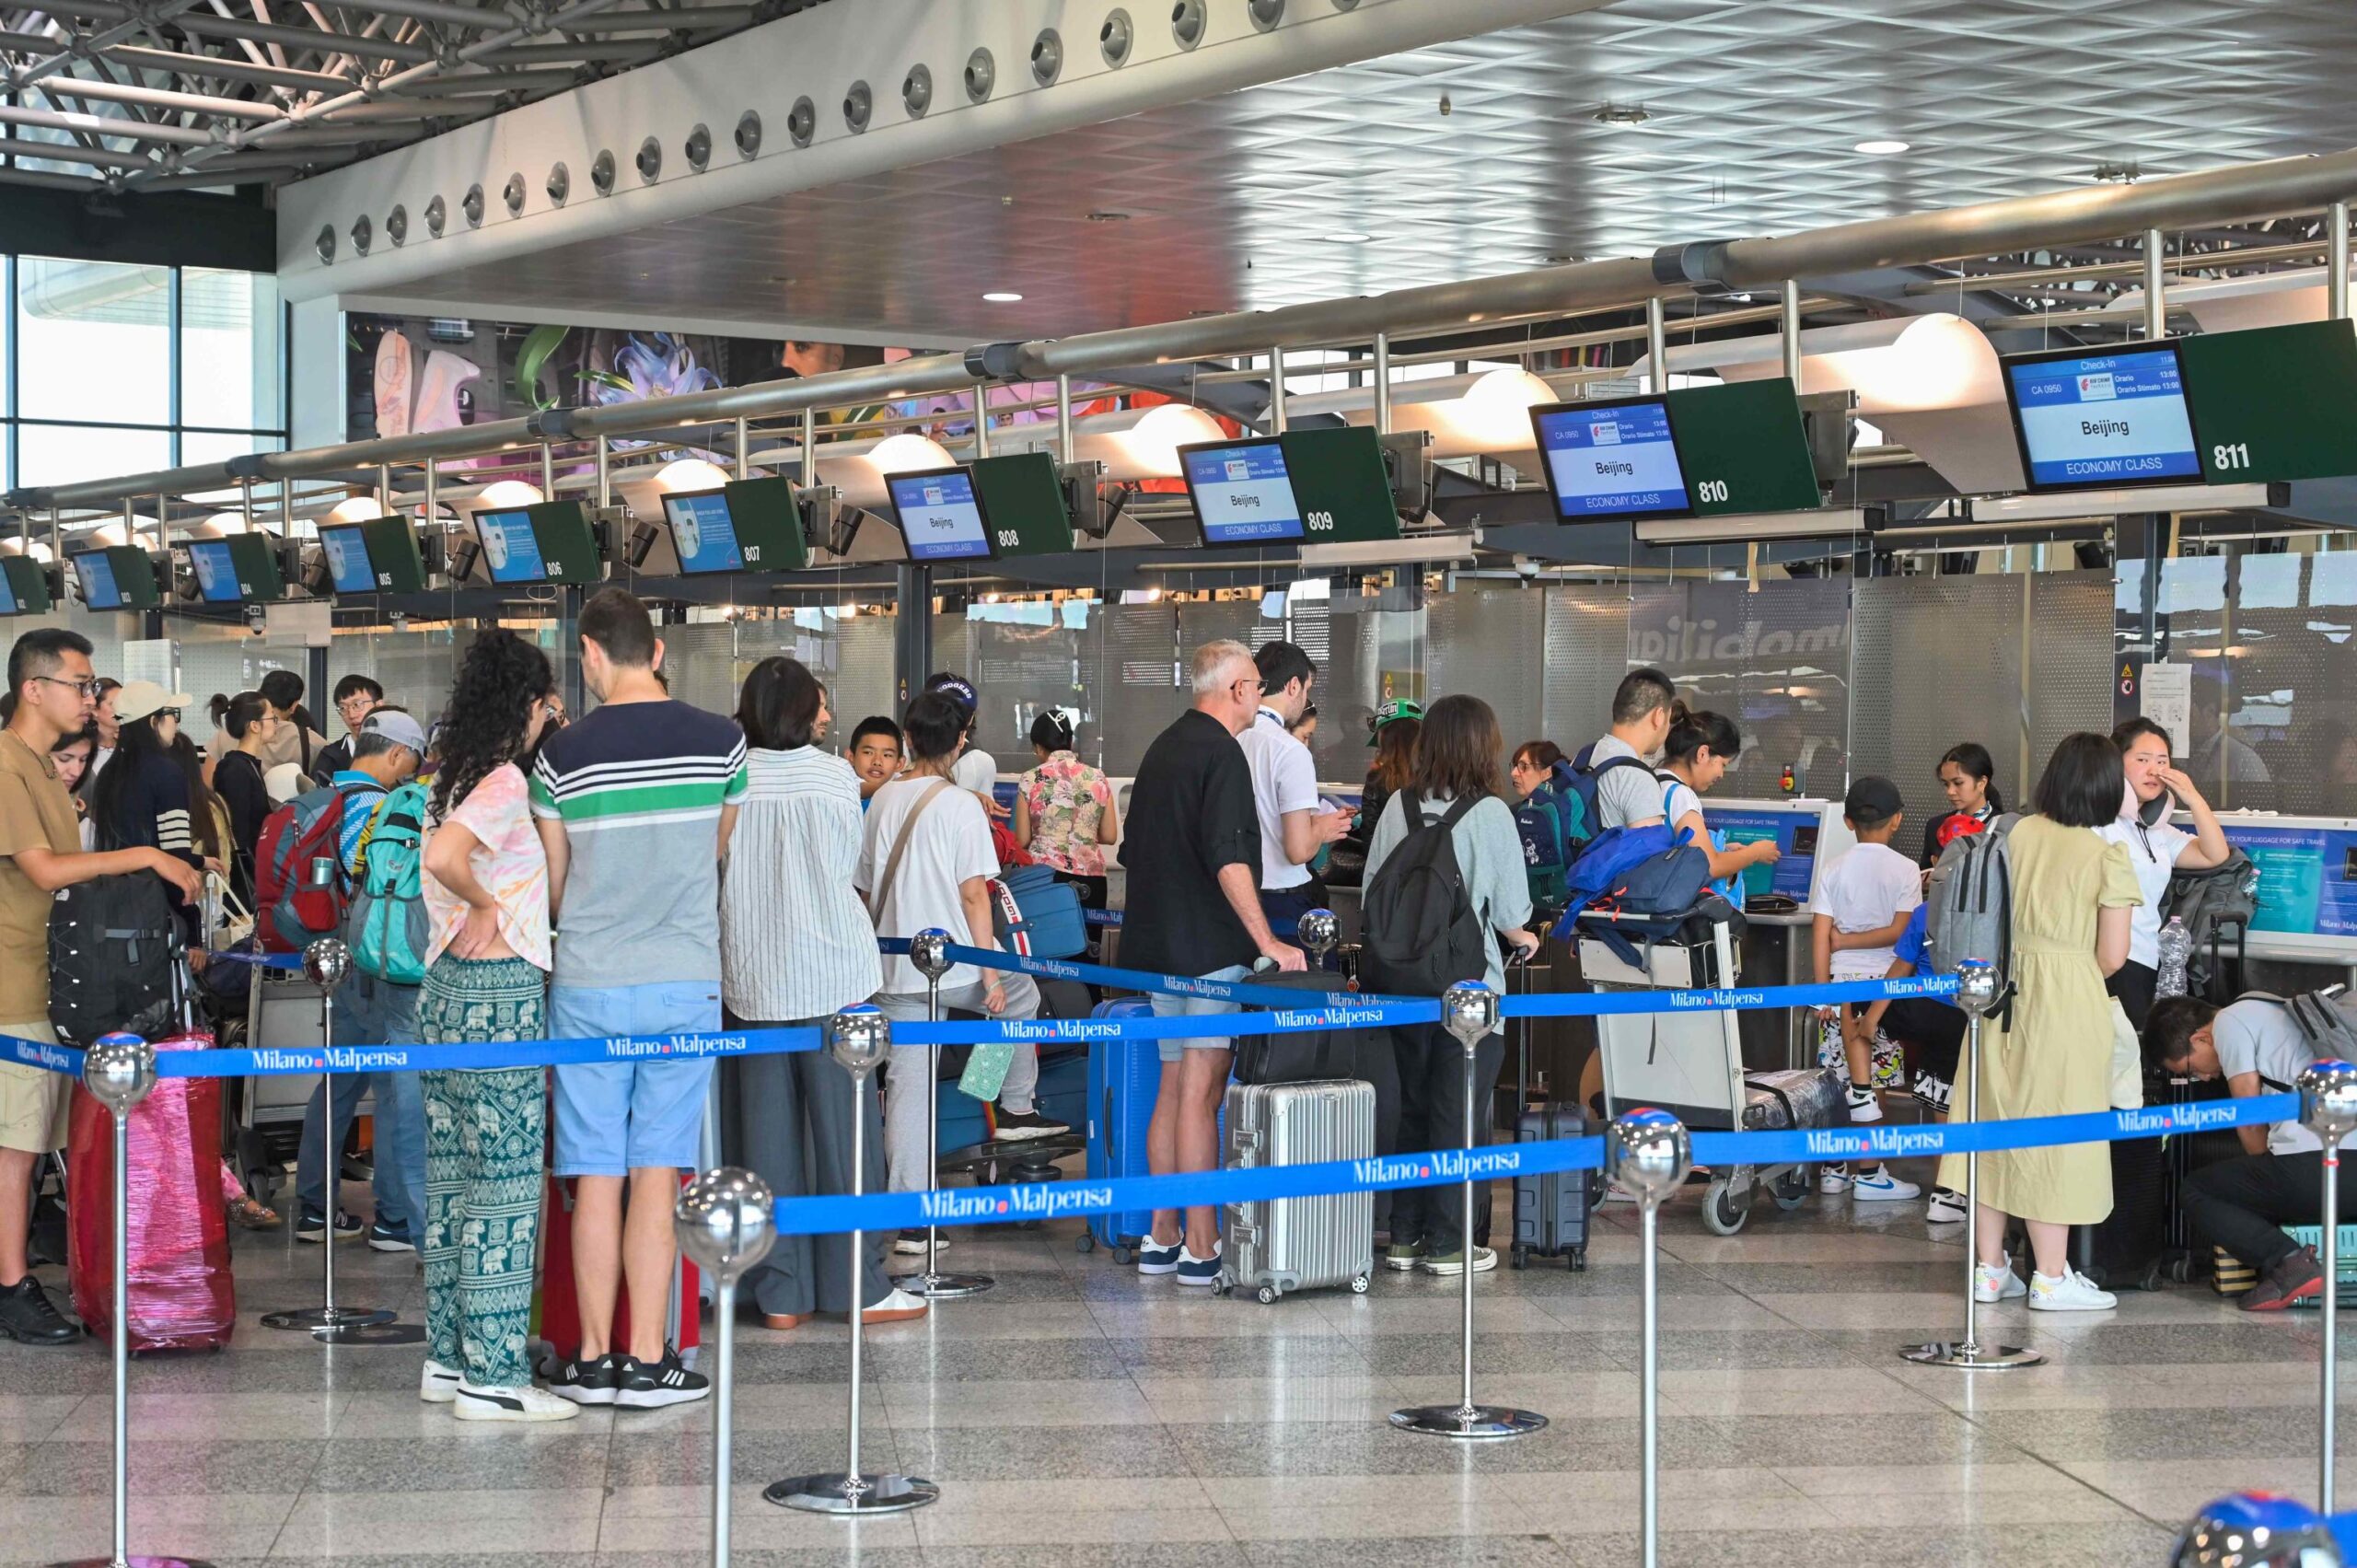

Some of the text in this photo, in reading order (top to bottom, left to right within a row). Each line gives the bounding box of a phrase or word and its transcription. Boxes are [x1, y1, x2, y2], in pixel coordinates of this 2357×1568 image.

[2081, 359, 2116, 371] Check-In
[2031, 383, 2062, 395] CA 0950
[2137, 384, 2161, 392] Stimato
[2162, 381, 2179, 389] 13:00
[1592, 410, 1620, 420] Check-In
[1555, 432, 1564, 440] CA
[2081, 419, 2130, 437] Beijing
[2213, 443, 2250, 470] 811
[1595, 461, 1633, 476] Beijing
[2066, 458, 2163, 476] ECONOMY CLASS
[1698, 480, 1729, 503] 810
[1230, 494, 1260, 507] Beijing
[1585, 493, 1661, 508] ECONOMY CLASS
[929, 517, 954, 529] Beijing
[1225, 523, 1283, 536] ECONOMY CLASS
[1307, 511, 1334, 531] 809
[998, 529, 1019, 547] 808
[744, 545, 760, 562] 807
[925, 542, 973, 553] ECONOMY CLASS
[546, 561, 563, 575] 806
[378, 572, 392, 586] 805
[2306, 838, 2326, 846] TRAVEL
[1086, 908, 1107, 922] Milano
[2320, 919, 2340, 929] Milano
[1019, 956, 1079, 976] Milano Malpensa
[1163, 975, 1231, 997] Milano Malpensa
[1883, 980, 1917, 995] Milano
[1326, 992, 1356, 1008] Milano
[1669, 991, 1763, 1008] Milano Malpensa
[1273, 1008, 1383, 1028] Milano Malpensa
[1001, 1019, 1120, 1041] Milano Malpensa
[606, 1034, 747, 1057] Milano Malpensa
[17, 1040, 69, 1069] Milano Malpensa
[252, 1047, 408, 1072] Milano Malpensa
[2116, 1104, 2237, 1132] Milano Malpensa
[1805, 1127, 1945, 1156] Milano Malpensa
[1353, 1150, 1520, 1185] Milano Malpensa
[920, 1184, 1113, 1218] Milano Malpensa
